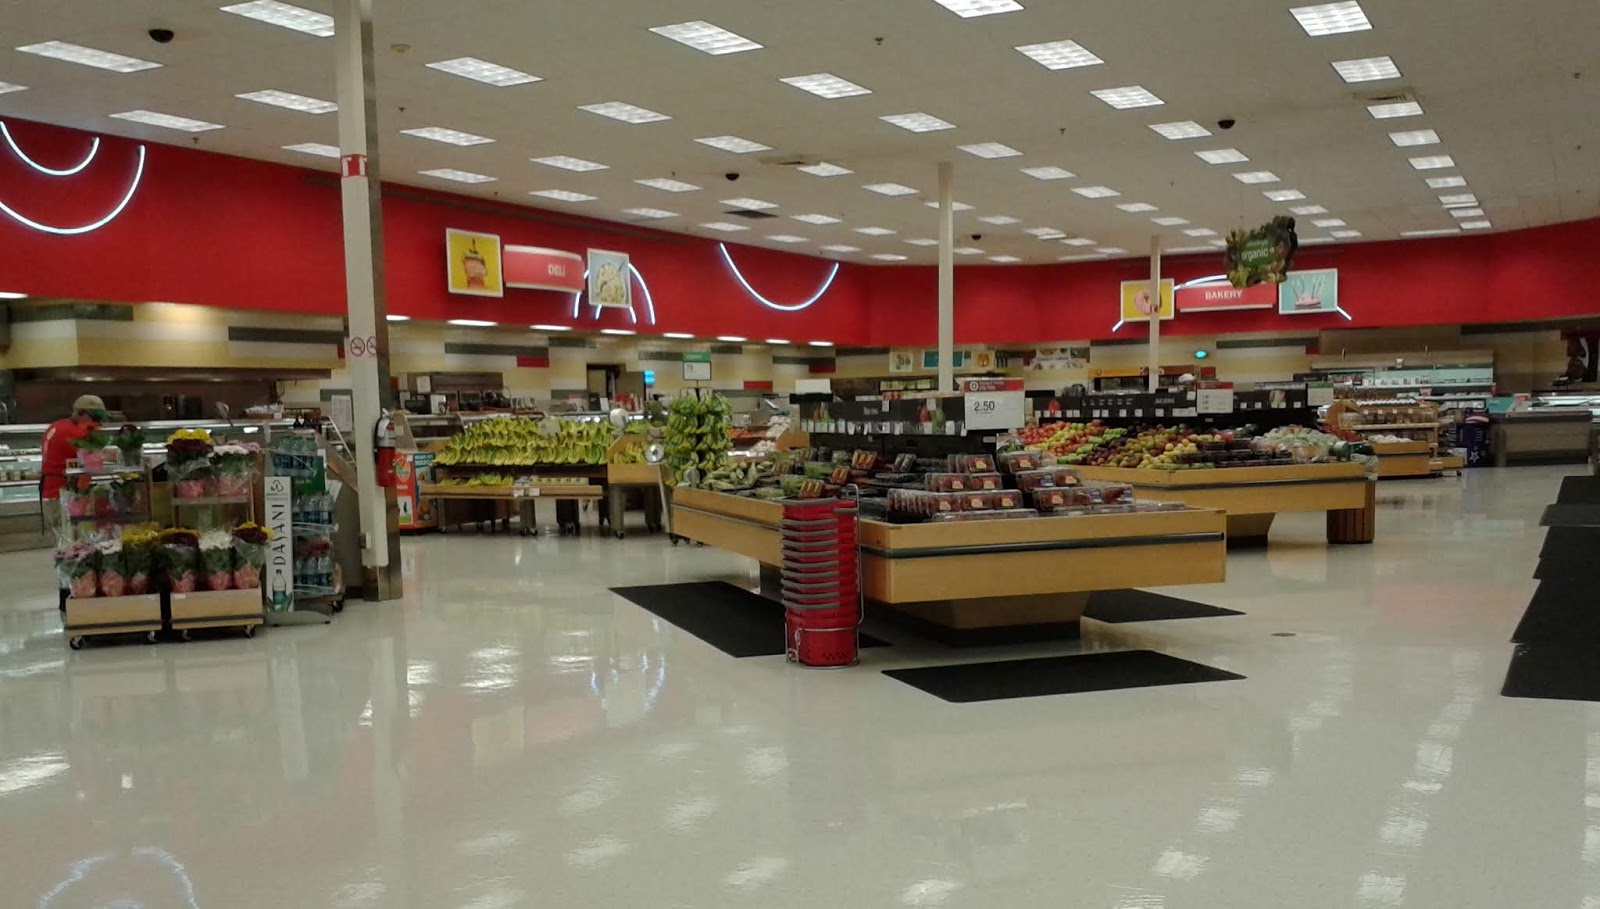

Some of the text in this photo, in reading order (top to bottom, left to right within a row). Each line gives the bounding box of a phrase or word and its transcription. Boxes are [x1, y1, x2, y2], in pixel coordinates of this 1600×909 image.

[1241, 246, 1268, 262] organic
[548, 264, 566, 277] DELI
[1205, 290, 1243, 300] BAKERY
[974, 400, 995, 412] 2.50
[272, 504, 286, 566] DASANI
